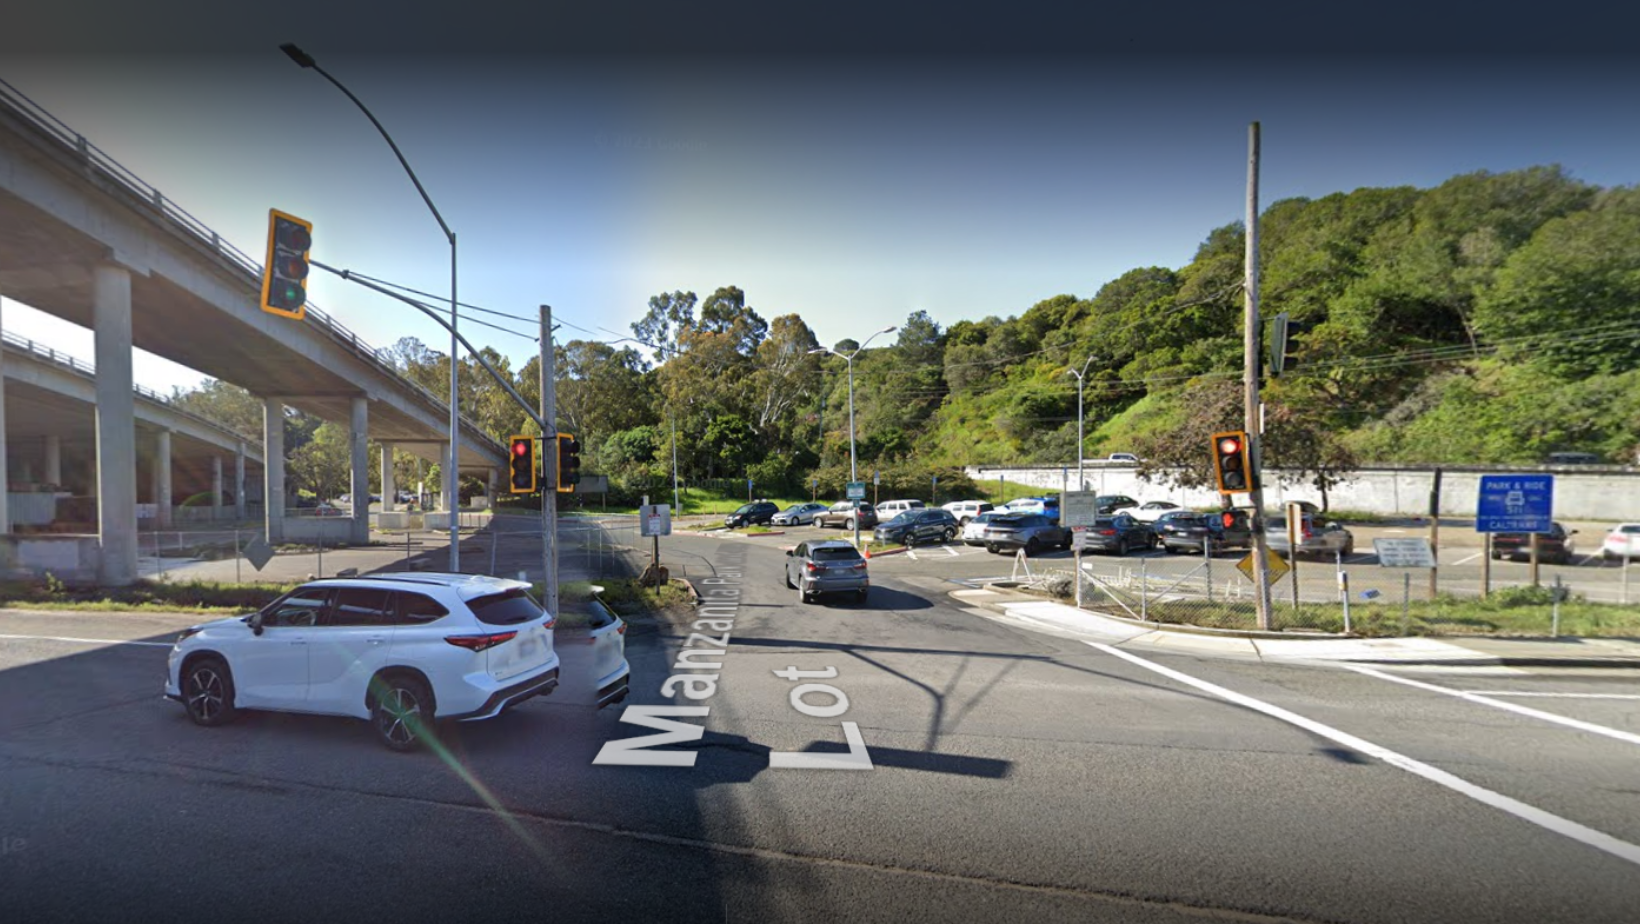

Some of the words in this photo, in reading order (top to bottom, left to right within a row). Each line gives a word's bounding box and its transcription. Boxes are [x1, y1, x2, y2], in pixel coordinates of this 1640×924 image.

[1486, 481, 1511, 490] PARK
[1513, 481, 1521, 490] &
[1524, 481, 1546, 490] RIDE
